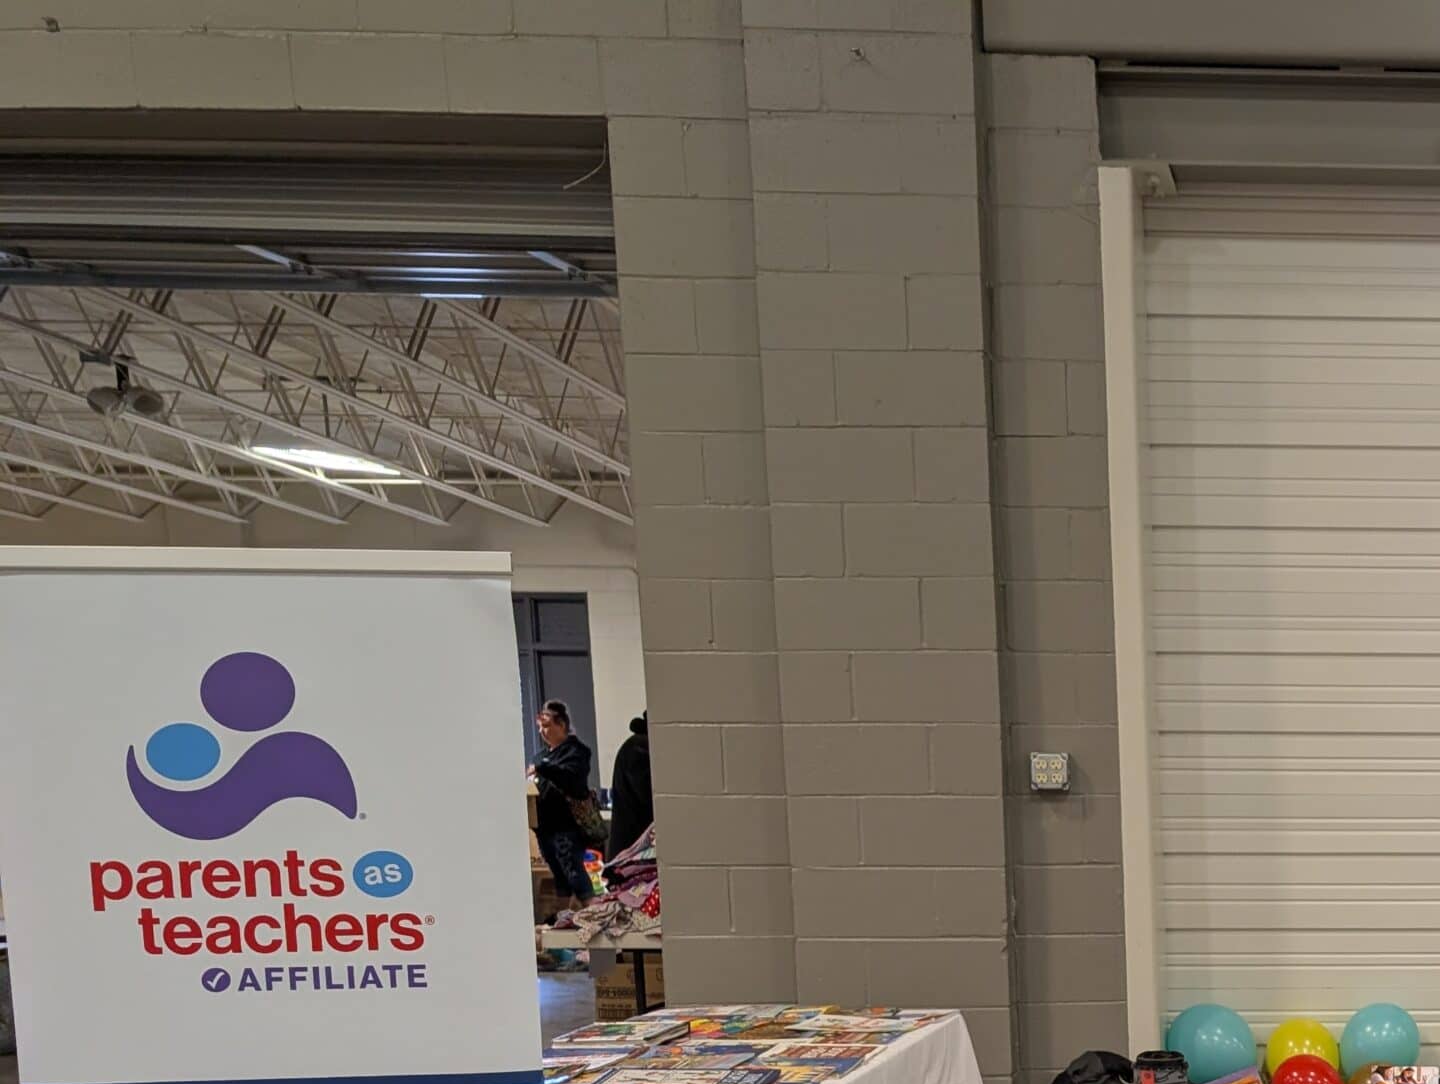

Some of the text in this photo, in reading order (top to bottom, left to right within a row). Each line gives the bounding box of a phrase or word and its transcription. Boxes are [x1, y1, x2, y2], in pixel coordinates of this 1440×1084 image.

[90, 849, 403, 912] parents as
[237, 963, 429, 993] AFFILIATE
